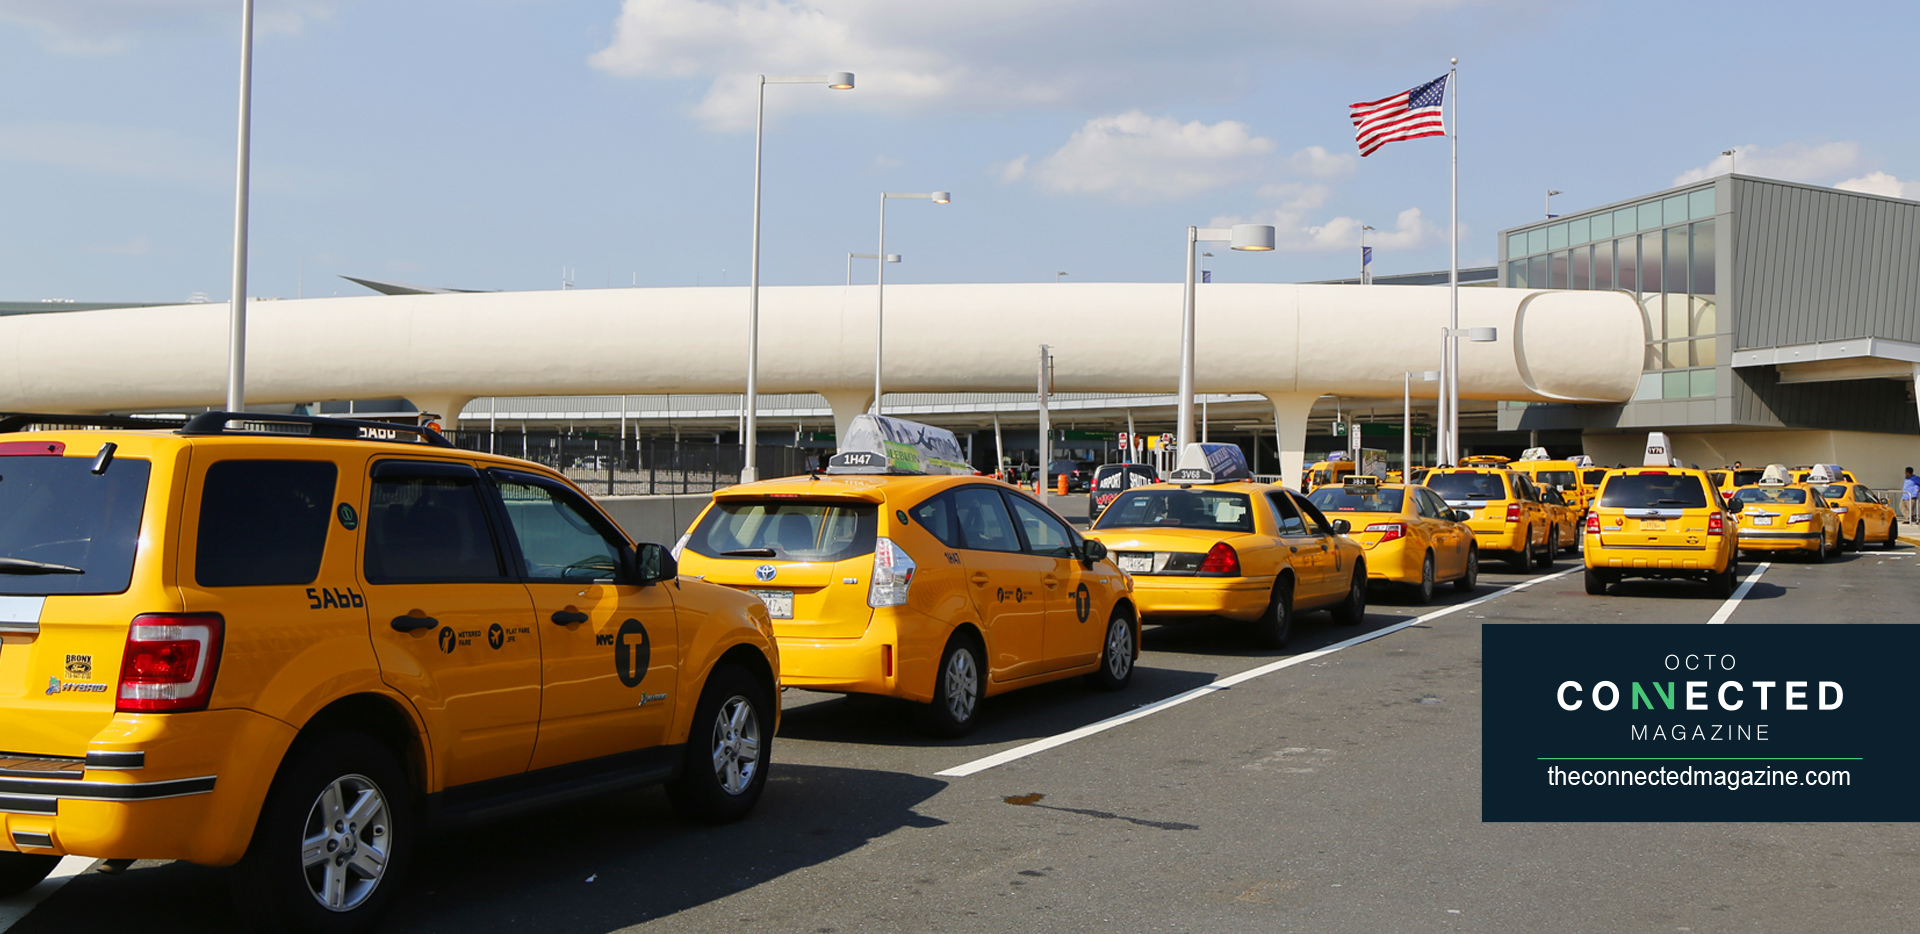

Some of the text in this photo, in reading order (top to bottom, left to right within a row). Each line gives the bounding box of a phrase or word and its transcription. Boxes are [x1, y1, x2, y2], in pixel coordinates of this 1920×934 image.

[843, 454, 872, 465] 1H47
[889, 448, 920, 464] LEBLON
[1099, 471, 1122, 489] AIRPORT
[1181, 470, 1201, 479] 3V68
[596, 634, 614, 646] NYC
[623, 633, 643, 678] T
[62, 683, 107, 692] HYBRID
